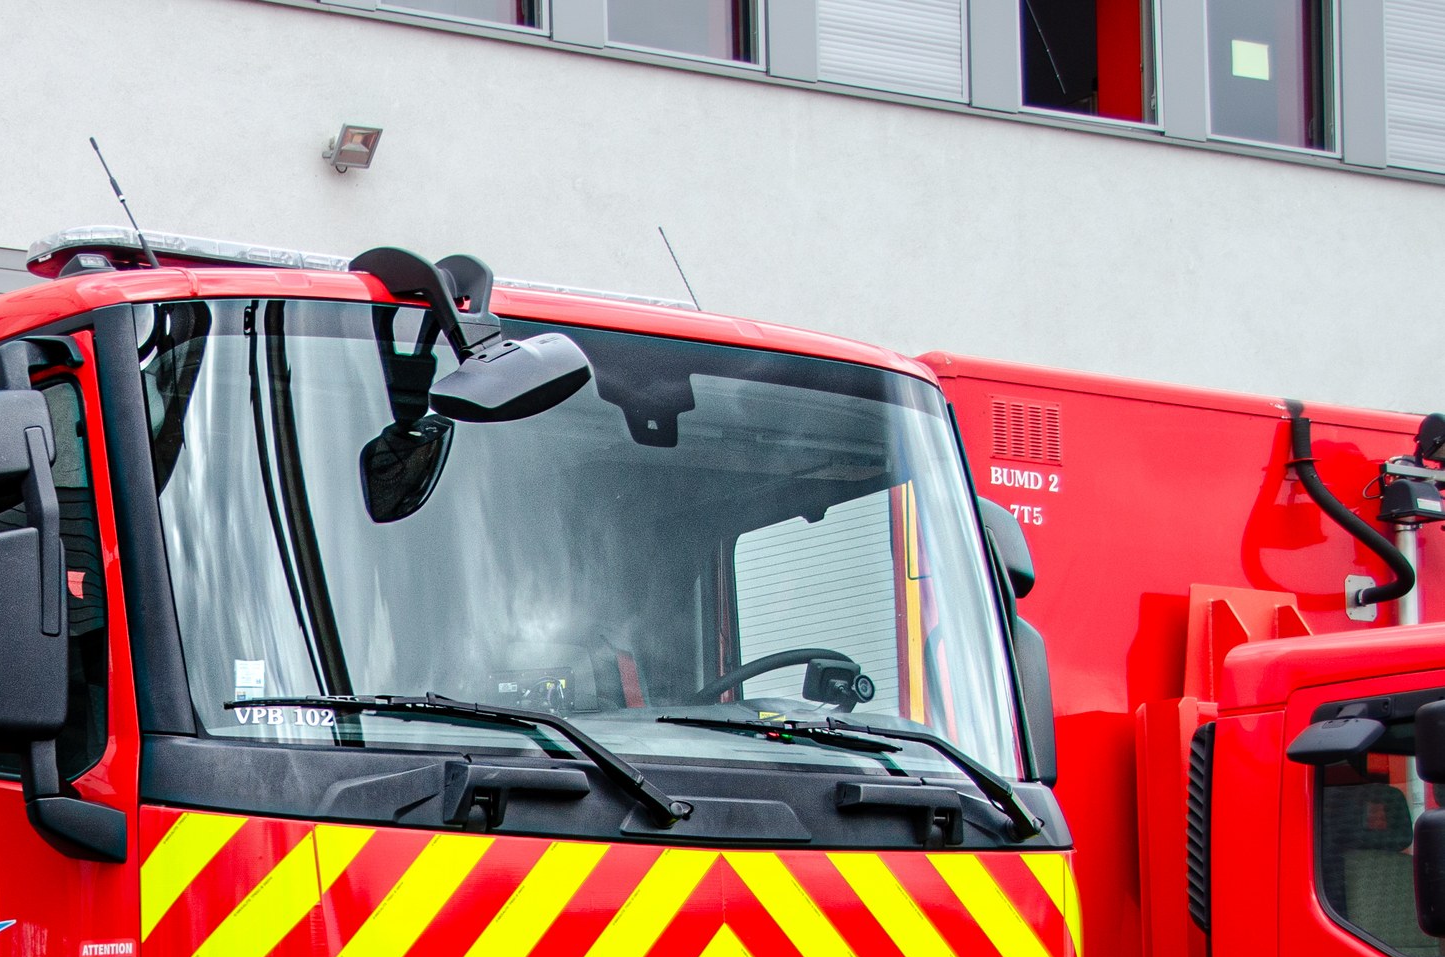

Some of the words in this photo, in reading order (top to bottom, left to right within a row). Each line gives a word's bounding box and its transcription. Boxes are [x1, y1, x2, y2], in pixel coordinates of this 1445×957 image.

[990, 466, 1043, 490] BUMD
[1048, 474, 1059, 492] 2
[1010, 504, 1043, 525] 7T5
[234, 706, 284, 725] VPB
[294, 708, 334, 727] 102
[82, 942, 133, 956] ATTENTION
